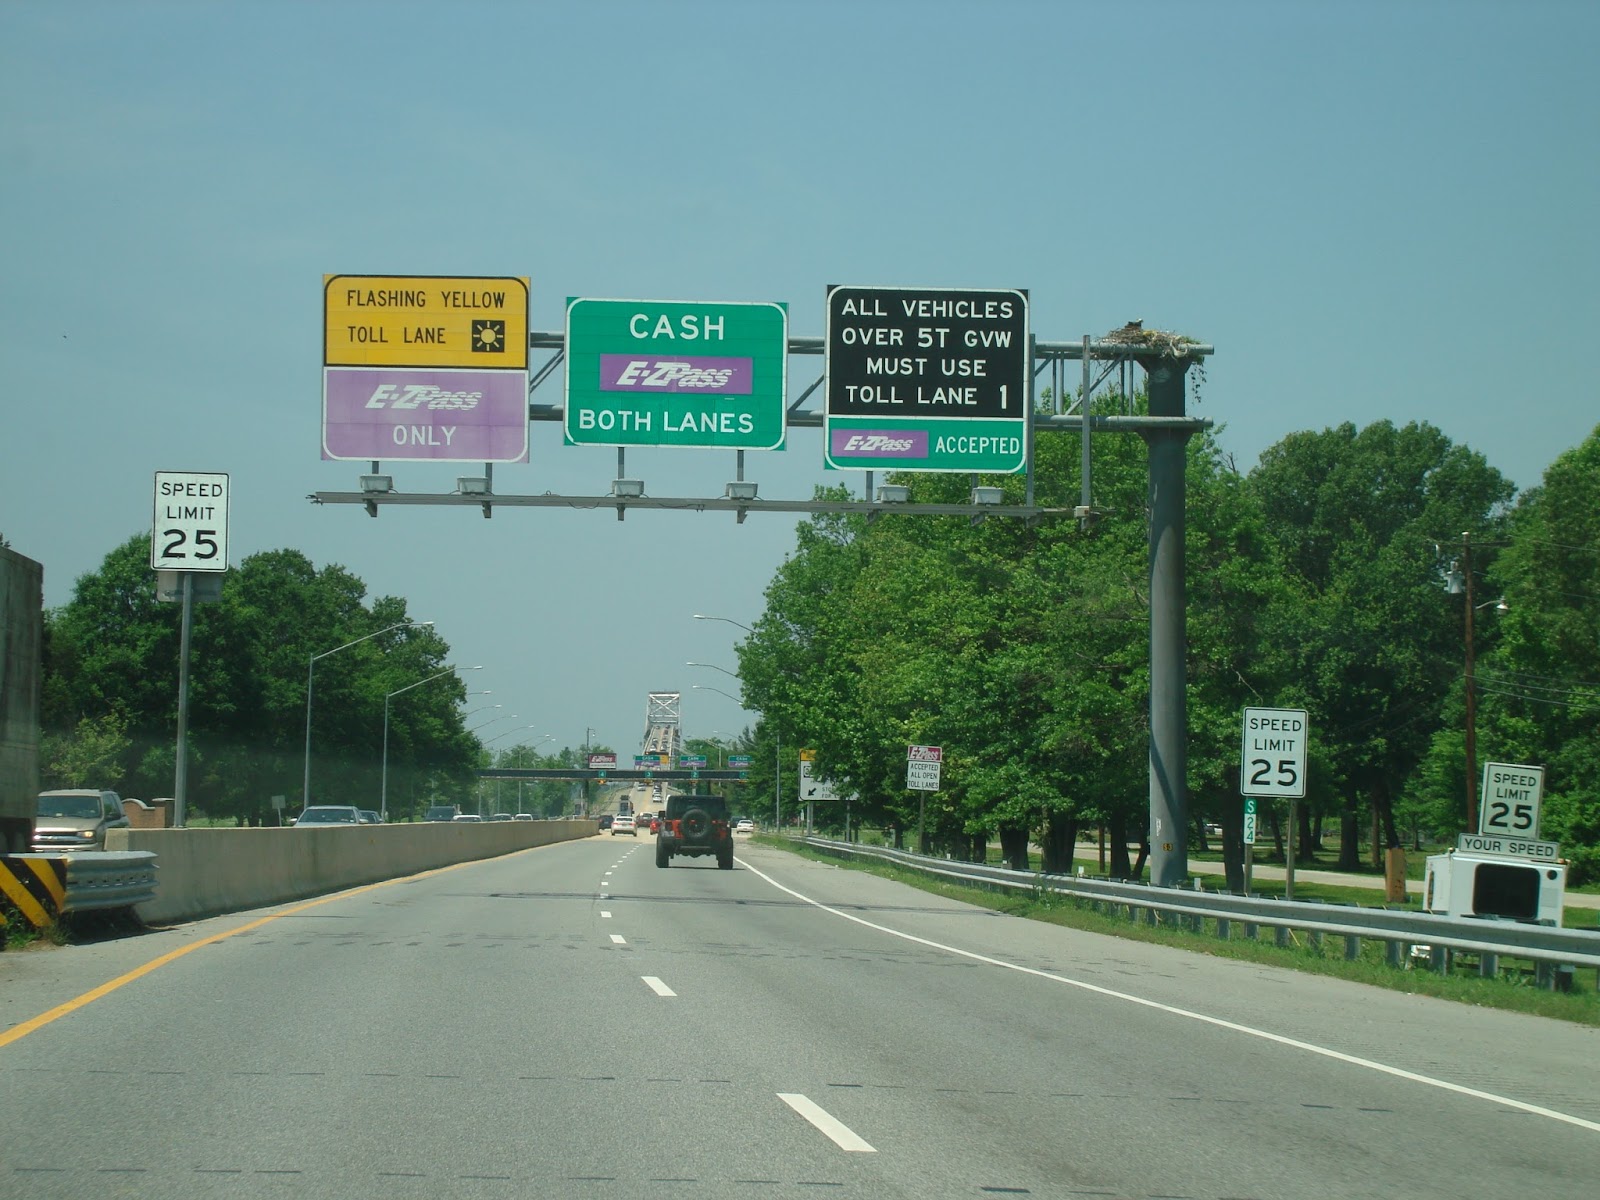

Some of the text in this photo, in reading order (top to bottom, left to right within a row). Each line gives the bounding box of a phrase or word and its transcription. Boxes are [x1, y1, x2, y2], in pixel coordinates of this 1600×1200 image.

[347, 290, 505, 308] FLASHING YELLOW
[842, 299, 1013, 318] ALL VEHICLES
[348, 326, 446, 344] TOLL LANE
[629, 314, 724, 340] CASH
[842, 328, 1012, 348] OVER 5T GVW
[866, 357, 987, 376] MUST USE
[845, 385, 1007, 409] TOLL LANE 1
[579, 409, 754, 433] BOTH LANES
[393, 425, 457, 446] ONLY
[935, 436, 1020, 454] ACCEPTED
[161, 482, 222, 497] SPEED
[167, 506, 215, 520] LIMIT
[162, 529, 218, 559] 25
[1249, 718, 1302, 732] SPEED
[1254, 738, 1295, 752] LIMIT
[911, 763, 938, 771] ACCEPTED
[1250, 759, 1297, 786] 25
[1493, 773, 1536, 787] SPEED
[1496, 788, 1530, 800] LIMIT
[1247, 801, 1255, 813] S
[1489, 802, 1532, 829] 25
[1465, 838, 1554, 857] YOUR SPEED
